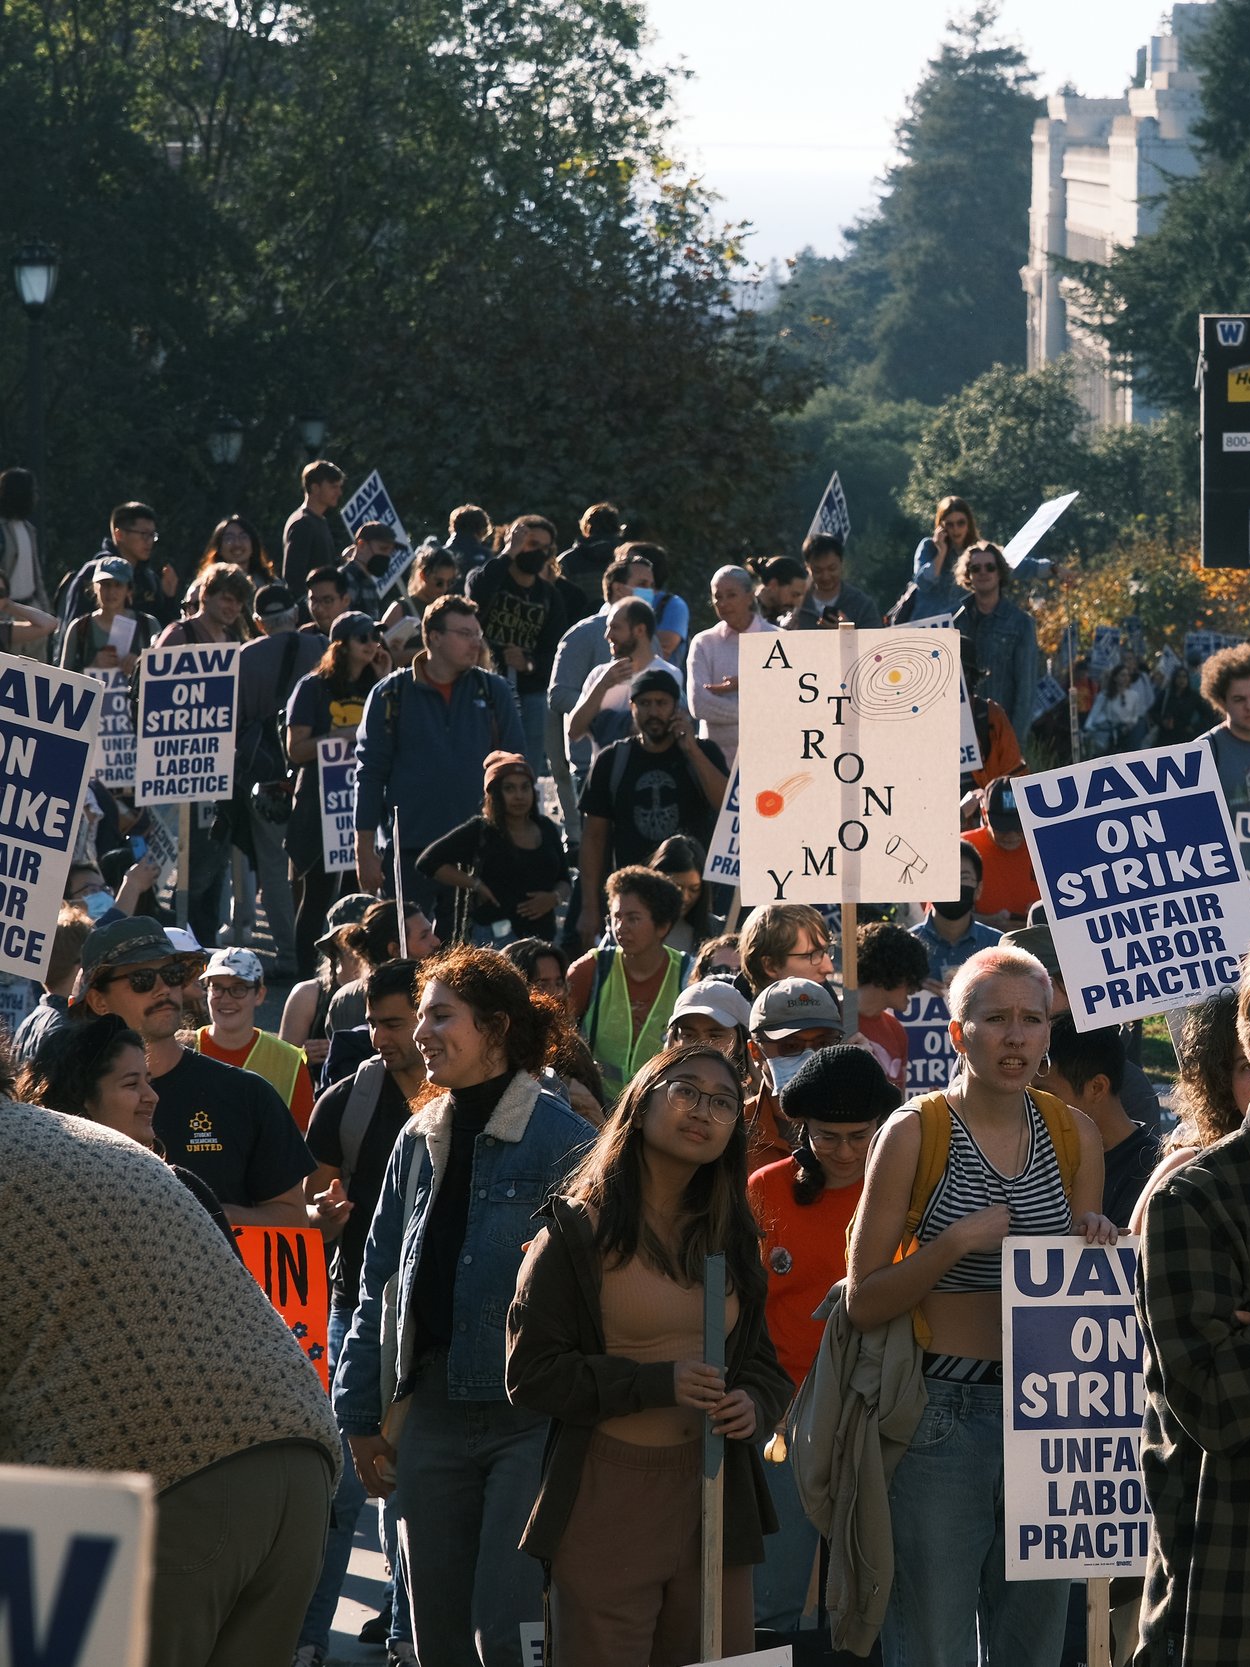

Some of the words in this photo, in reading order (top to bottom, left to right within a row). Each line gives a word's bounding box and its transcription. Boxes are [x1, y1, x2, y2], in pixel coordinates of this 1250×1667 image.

[344, 476, 379, 522] UAW
[90, 671, 128, 689] UA
[147, 649, 236, 676] UAW
[0, 667, 96, 732] AW
[172, 682, 206, 706] ON
[146, 706, 230, 733] STRIKE
[102, 737, 137, 751] UNFA
[153, 736, 219, 757] UNFAIR
[142, 775, 228, 797] PRACTICE
[156, 757, 215, 777] LABOR
[1024, 750, 1203, 818] UAW
[0, 784, 71, 838] IKE
[1096, 809, 1166, 854] ON
[1056, 842, 1230, 907] STRIKE
[1086, 893, 1224, 944] UNFAIR
[1101, 925, 1226, 975] LABOR
[1081, 954, 1243, 1014] PRACTIC
[894, 997, 952, 1022] UA
[186, 1144, 223, 1152] UNITED
[1070, 1316, 1137, 1363] ON
[1019, 1371, 1146, 1419] STRI
[1040, 1436, 1141, 1474] UNFA
[1019, 1522, 1148, 1560] PRACTI
